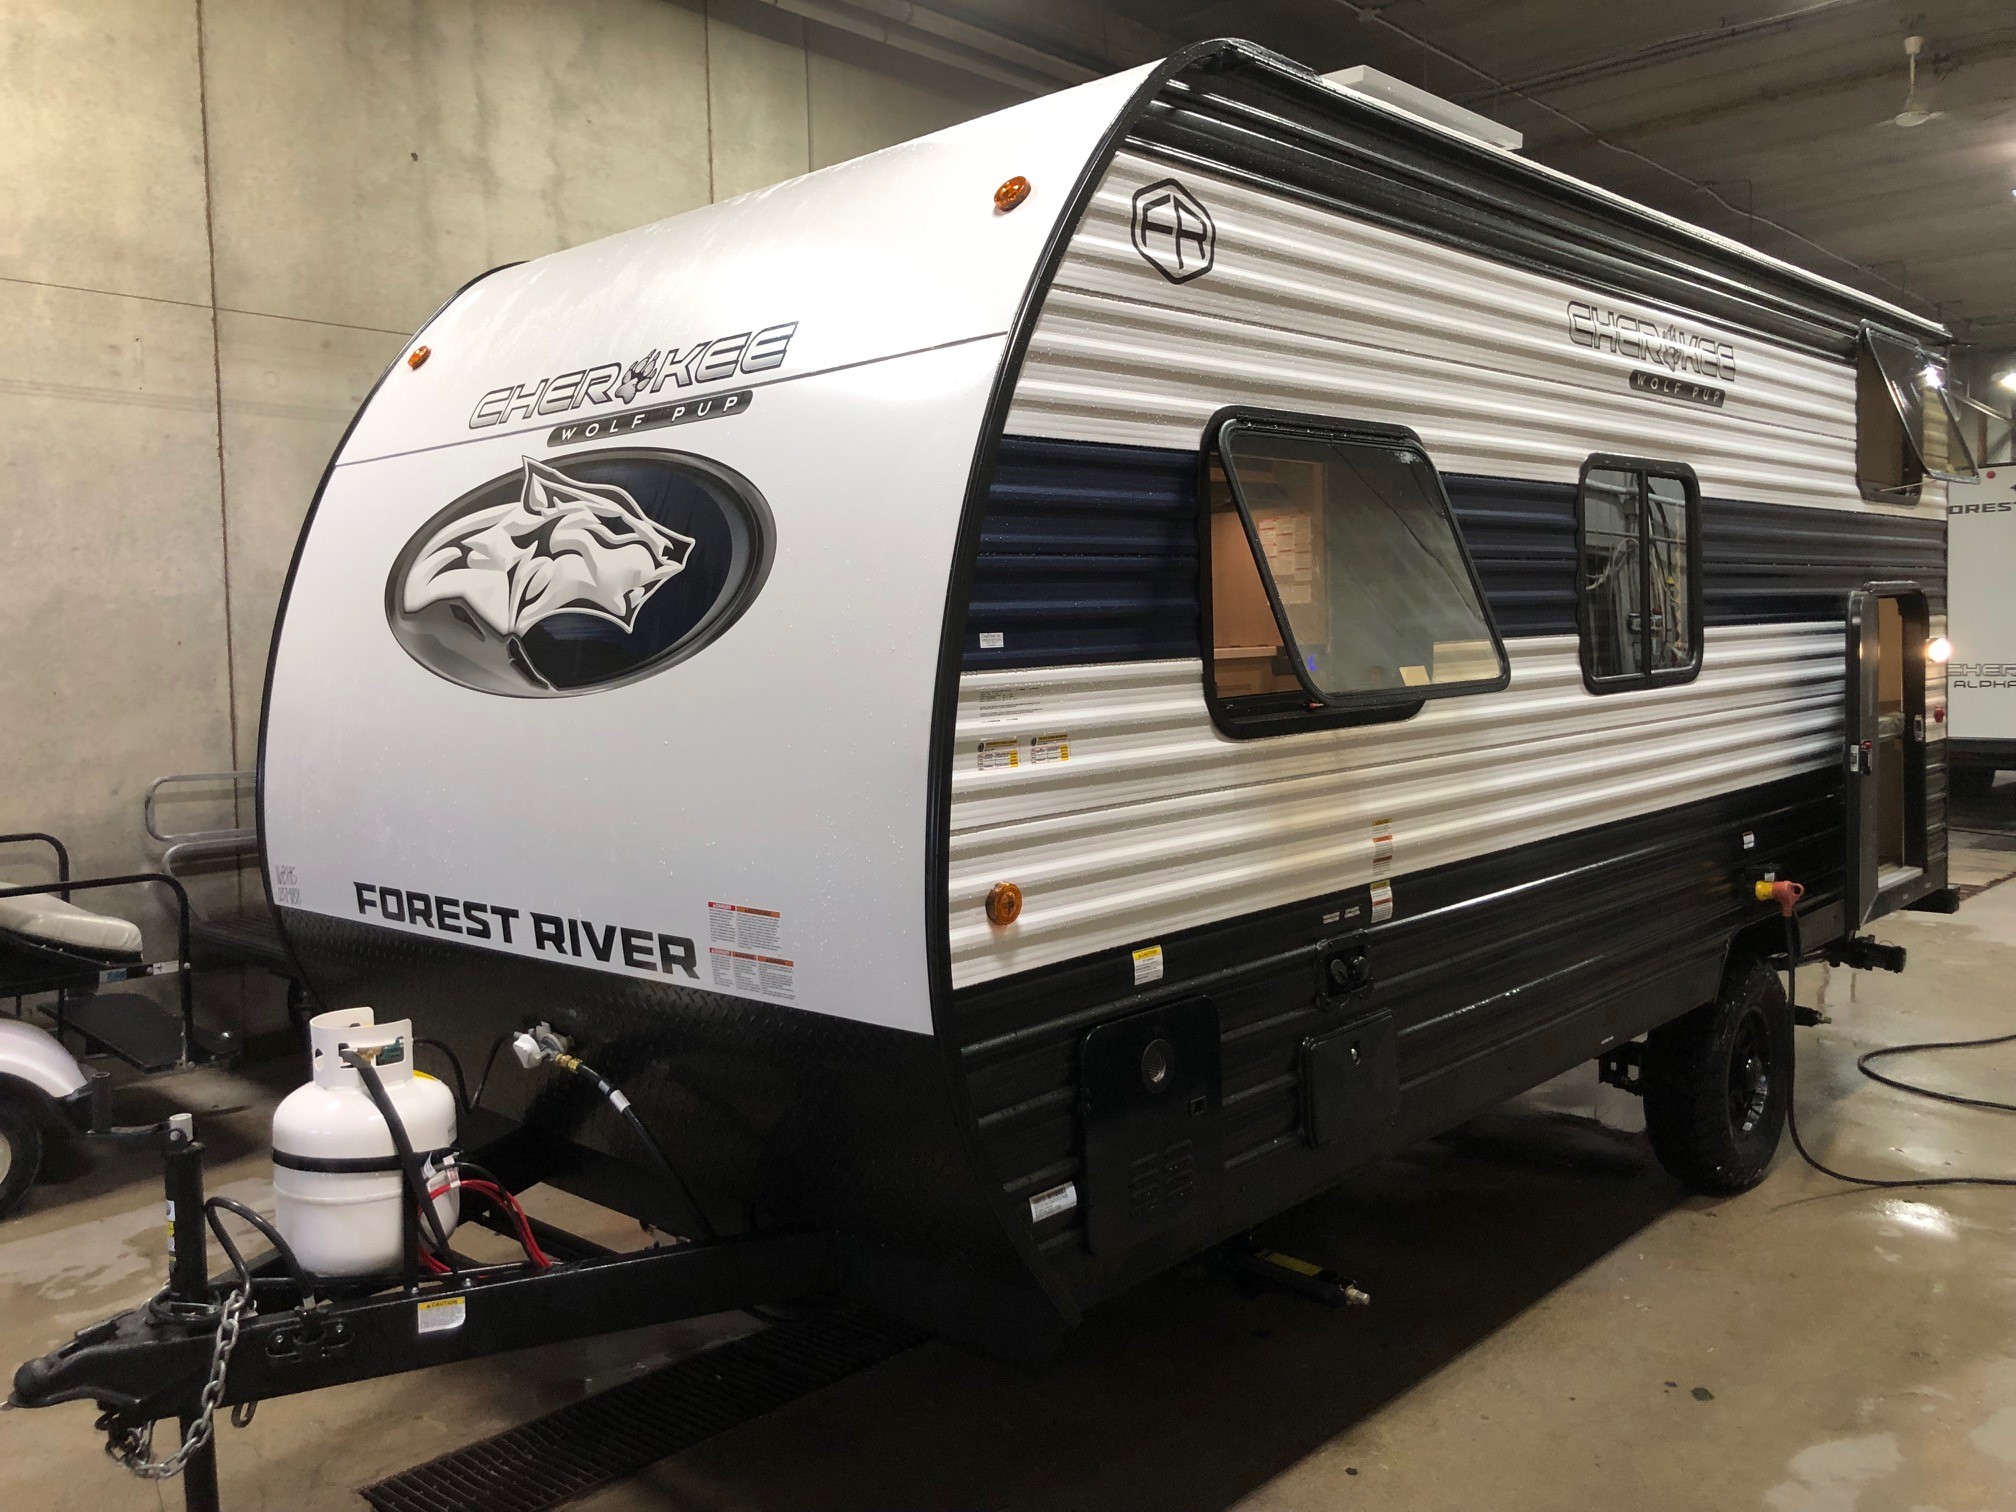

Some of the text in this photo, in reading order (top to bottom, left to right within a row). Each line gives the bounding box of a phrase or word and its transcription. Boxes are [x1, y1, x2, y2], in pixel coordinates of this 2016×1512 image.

[1637, 373, 1720, 402] WOLF PUP
[561, 396, 739, 442] WOLF PUP
[353, 881, 519, 944] FOREST
[529, 911, 701, 979] RIVER
